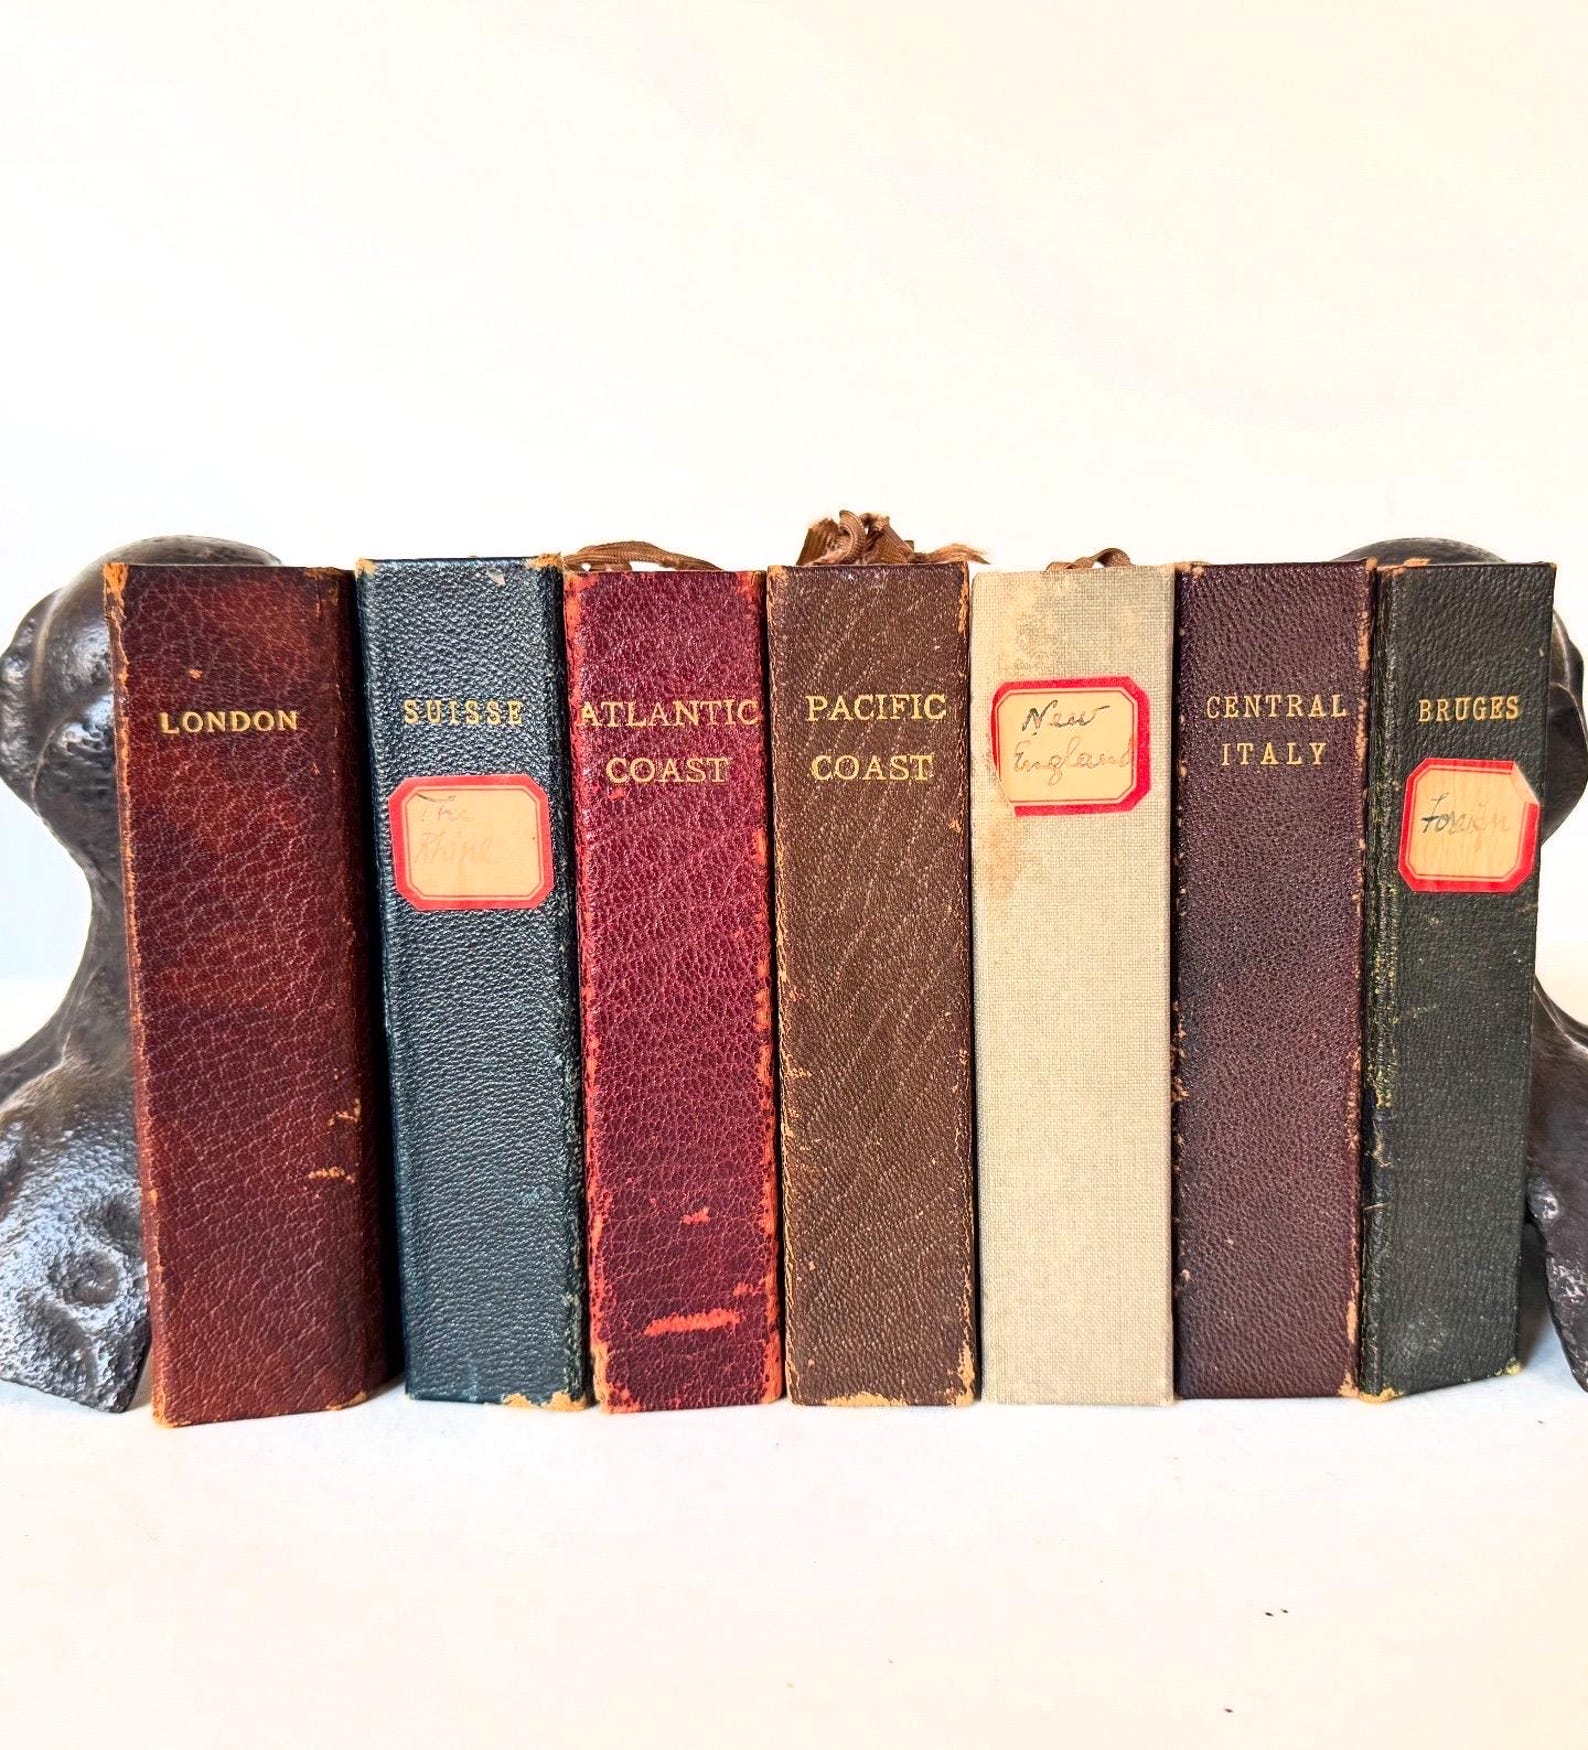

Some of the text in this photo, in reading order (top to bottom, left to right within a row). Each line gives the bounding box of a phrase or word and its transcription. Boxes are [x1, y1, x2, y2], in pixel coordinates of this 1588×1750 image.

[402, 699, 524, 726] SUISSE
[579, 698, 760, 728] ATLANTIC
[806, 693, 948, 722] PACIFIC
[1021, 699, 1111, 731] New
[1205, 694, 1348, 720] CENTRAL
[1418, 694, 1520, 723] BRUGES
[160, 709, 299, 735] LONDON
[810, 753, 935, 782] COAST
[1012, 736, 1132, 785] England
[1221, 742, 1328, 767] ITALY
[605, 756, 732, 784] COAST
